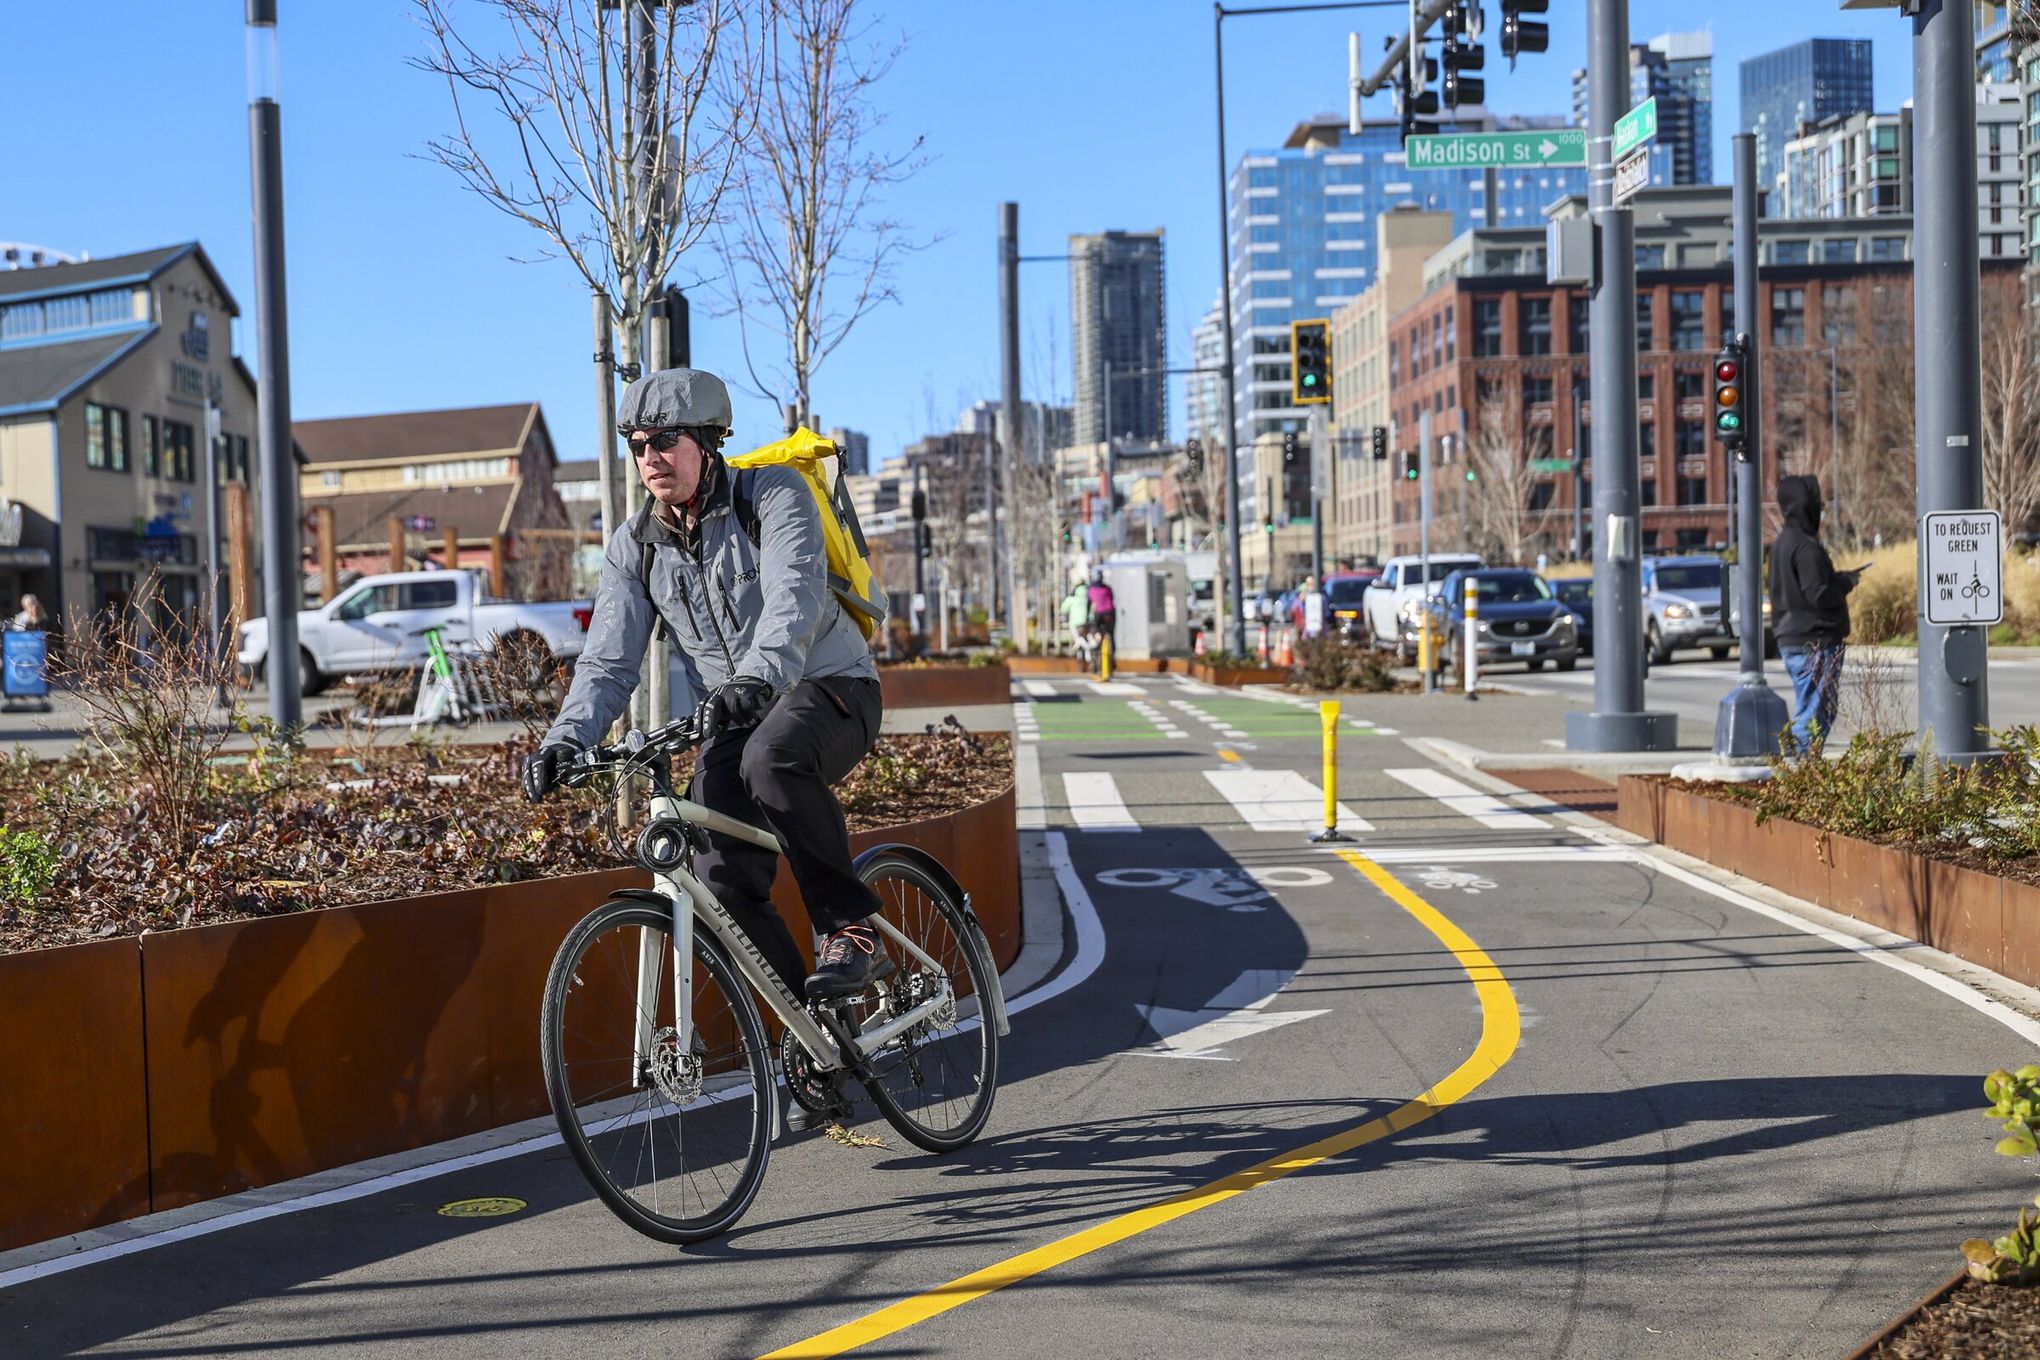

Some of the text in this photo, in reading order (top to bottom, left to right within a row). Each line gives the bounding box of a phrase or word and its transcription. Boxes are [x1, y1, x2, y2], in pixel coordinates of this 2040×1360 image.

[1558, 132, 1583, 144] 1000
[1414, 138, 1531, 164] Madison St
[1935, 522, 1991, 536] TO REQUEST
[1948, 540, 1978, 552] GREEN
[737, 562, 760, 585] PROV
[1936, 573, 1958, 585] WAIT
[1940, 588, 1953, 600] ON
